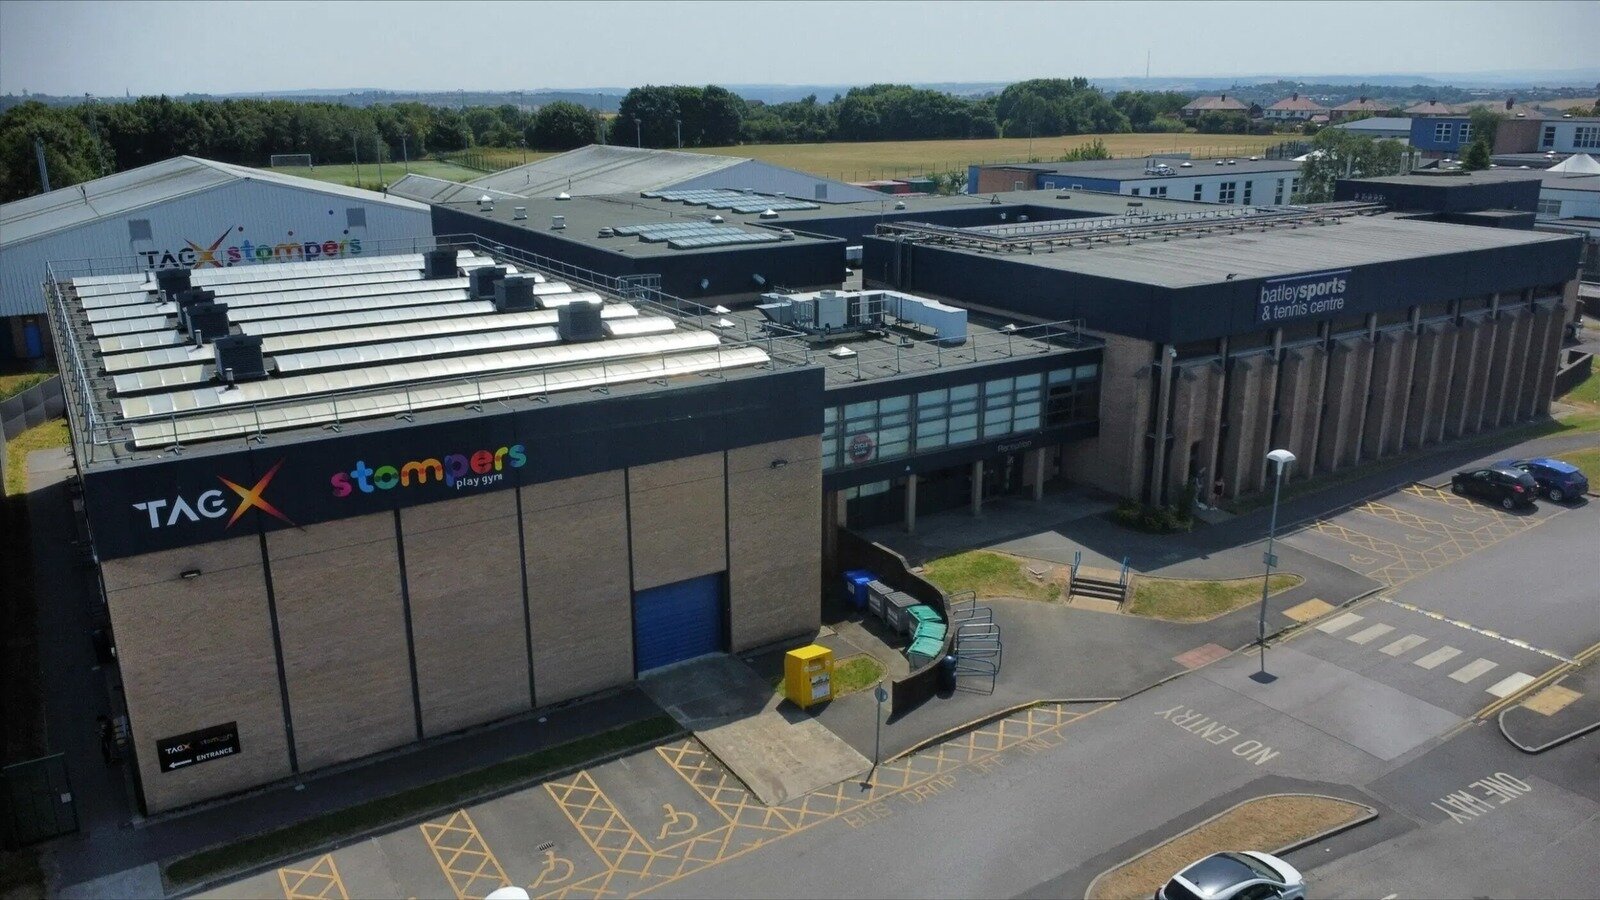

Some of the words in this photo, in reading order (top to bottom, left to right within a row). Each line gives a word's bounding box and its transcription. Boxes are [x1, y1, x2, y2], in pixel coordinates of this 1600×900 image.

[139, 225, 234, 269] TAGX
[227, 238, 361, 263] stompers
[1261, 305, 1271, 321] &
[1273, 300, 1308, 319] tennis
[1310, 296, 1345, 314] centre
[132, 456, 299, 530] TAGX
[330, 444, 527, 497] stompers
[456, 478, 479, 490] play
[481, 473, 503, 486] gym
[1154, 705, 1240, 745] ENTRY
[196, 746, 233, 762] ENTRANCE
[1231, 740, 1281, 766] NO
[1468, 772, 1532, 804] ONE
[1430, 789, 1496, 824] WAY
